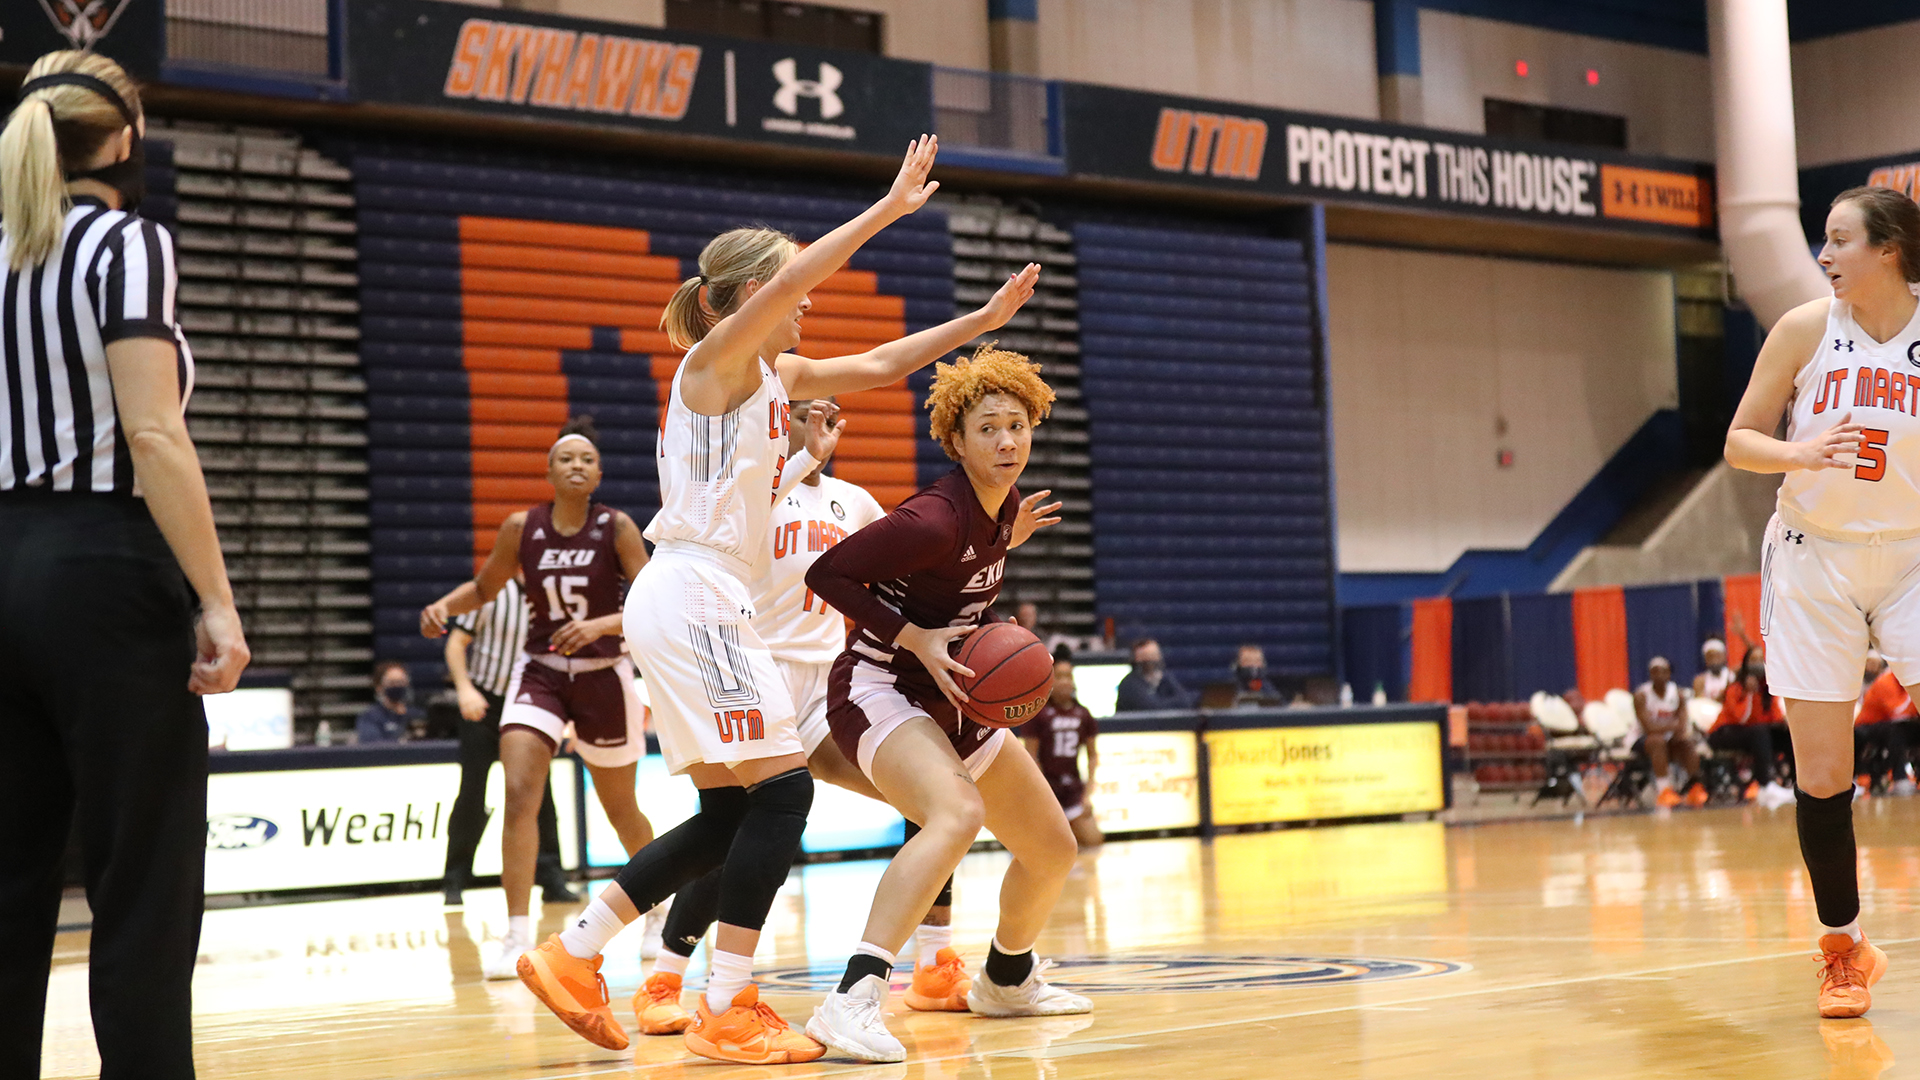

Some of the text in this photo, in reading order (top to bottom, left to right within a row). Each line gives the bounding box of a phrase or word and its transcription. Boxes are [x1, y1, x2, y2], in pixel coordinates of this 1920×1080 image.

[444, 18, 701, 121] SKYHAWKS
[1152, 107, 1268, 181] UTM
[1286, 124, 1430, 198] PROTECT
[1432, 142, 1490, 206] THIS
[1813, 366, 1920, 417] UT MART
[1855, 427, 1889, 482] 5
[537, 549, 595, 570] EKU
[774, 520, 802, 560] UT
[960, 556, 1006, 593] EKU
[542, 575, 588, 621] 15
[714, 709, 764, 743] UTM
[1052, 730, 1080, 758] 12
[1280, 736, 1333, 766] Jones
[301, 802, 441, 847] Weakl
